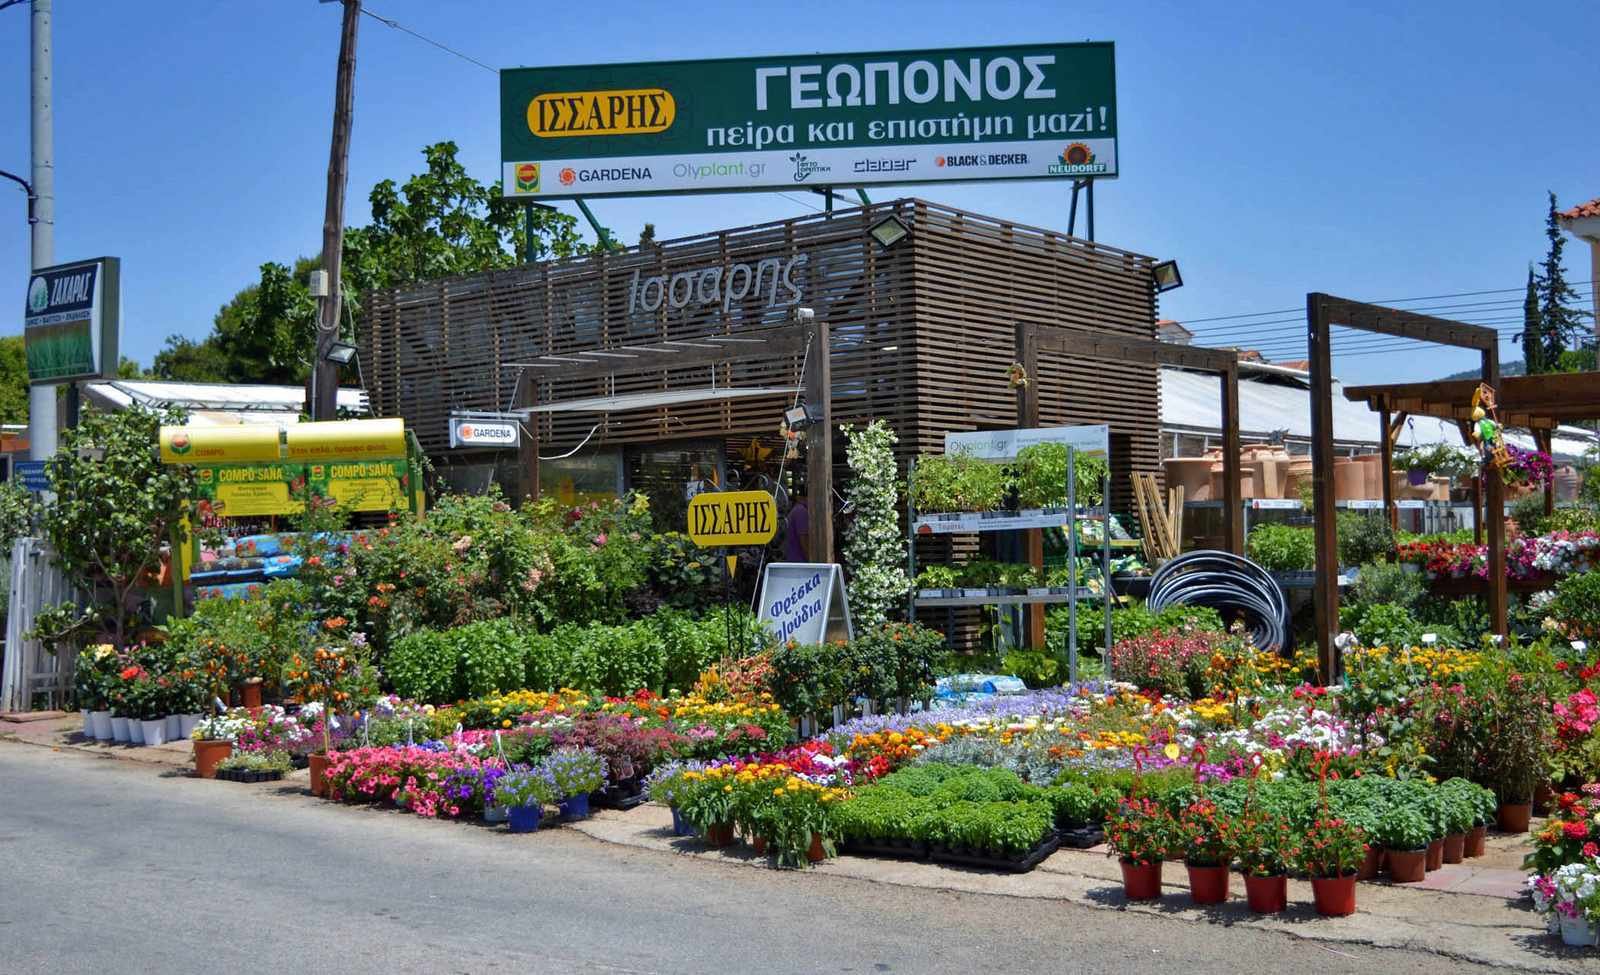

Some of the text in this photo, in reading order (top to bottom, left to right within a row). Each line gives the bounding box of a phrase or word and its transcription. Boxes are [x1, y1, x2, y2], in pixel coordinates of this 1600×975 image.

[755, 55, 1056, 111] ΓΕΩΠΟΝΟΣ
[536, 91, 668, 132] ΙΣΣΑΡΗΣ
[706, 121, 795, 150] πείρα
[808, 120, 854, 142] και
[868, 112, 1013, 141] επιστήμη
[578, 168, 652, 182] GARDENA
[673, 160, 767, 180] Olyplant.gr
[1049, 164, 1105, 174] NEUDORFF
[473, 428, 512, 438] GARDENA
[219, 465, 283, 482] COMPO SANA
[331, 463, 394, 478] COMPO SANA
[693, 501, 771, 536] ΙΣΣΑΡΗΣ
[770, 573, 821, 617] Φρέσκα
